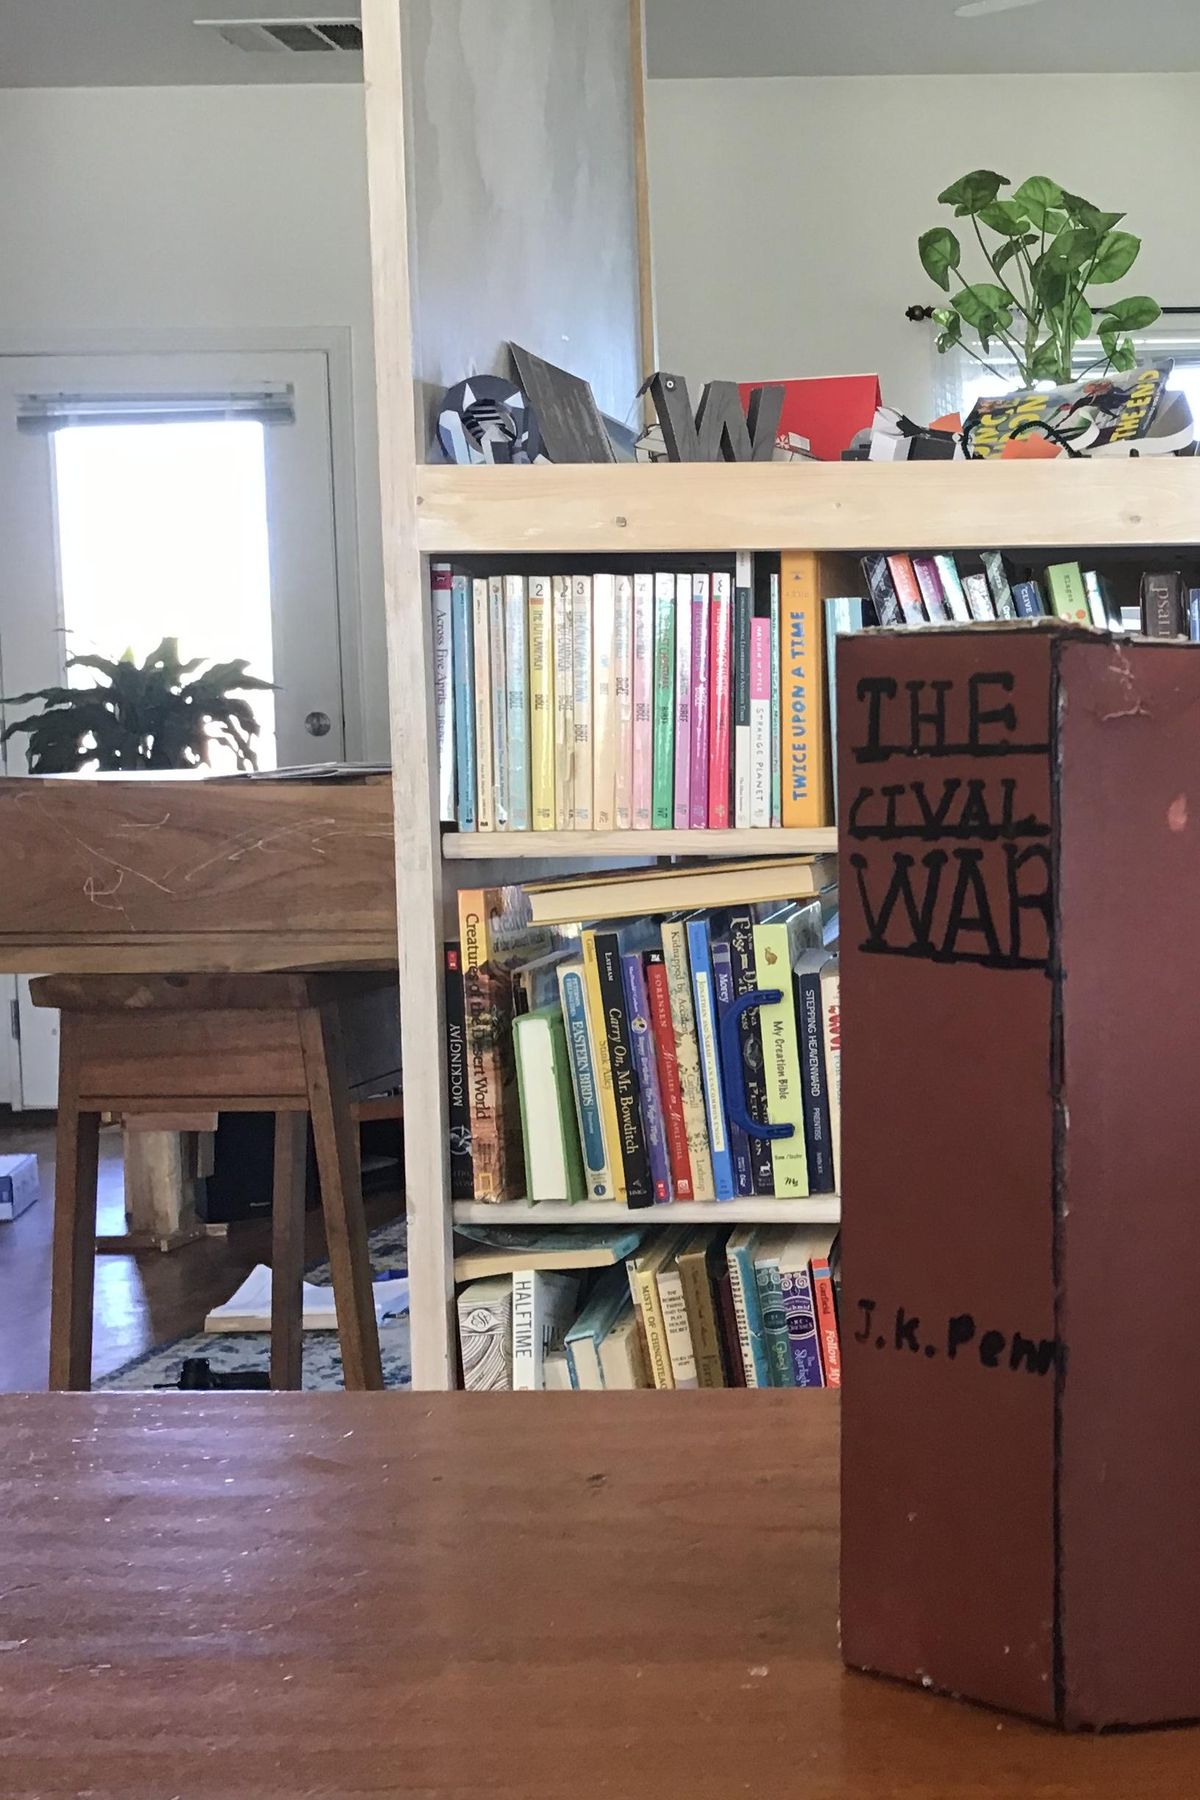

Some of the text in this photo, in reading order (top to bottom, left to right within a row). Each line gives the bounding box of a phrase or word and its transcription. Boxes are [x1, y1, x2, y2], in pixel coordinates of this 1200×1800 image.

[1110, 370, 1160, 442] THE END
[536, 584, 543, 596] 2
[577, 582, 584, 594] 3
[698, 581, 704, 594] 7
[436, 610, 447, 645] Across
[437, 649, 448, 669] Five
[434, 672, 447, 705] Aprils
[790, 612, 807, 801] TWICE UPON A TIME
[856, 672, 1017, 763] THE
[756, 708, 764, 801] STRANGE PLANET
[848, 778, 1050, 841] CIVAL
[850, 842, 1053, 970] WAR
[466, 913, 480, 979] Creatures
[604, 952, 614, 981] LATHAM
[470, 985, 482, 997] of
[654, 973, 667, 1029] SORENSEN
[671, 931, 689, 1036] Kidnapped by Accident
[697, 979, 708, 1019] JONATHAN
[718, 973, 729, 1003] Morey
[471, 1002, 483, 1026] the
[449, 1024, 463, 1107] MOCKINGJAY
[573, 1020, 594, 1106] EASTERN BIRDS
[598, 1040, 613, 1090] Stink Alley
[773, 1021, 790, 1100] My Creation Bible
[805, 989, 820, 1097] STEPPING HEAVENWARD
[475, 1078, 490, 1120] World
[607, 1007, 636, 1154] Carry On, Mr. Bowditch
[661, 1044, 683, 1160] MIRACLES MAPLE HILL
[812, 1107, 822, 1141] PRENTISS
[696, 1159, 707, 1192] Lothrop
[515, 1281, 532, 1358] HALFTIME
[642, 1285, 653, 1312] MISTY
[819, 1283, 830, 1314] Garfield
[647, 1317, 658, 1329] OF
[773, 1341, 787, 1370] Ghost
[825, 1330, 840, 1384] Follow My
